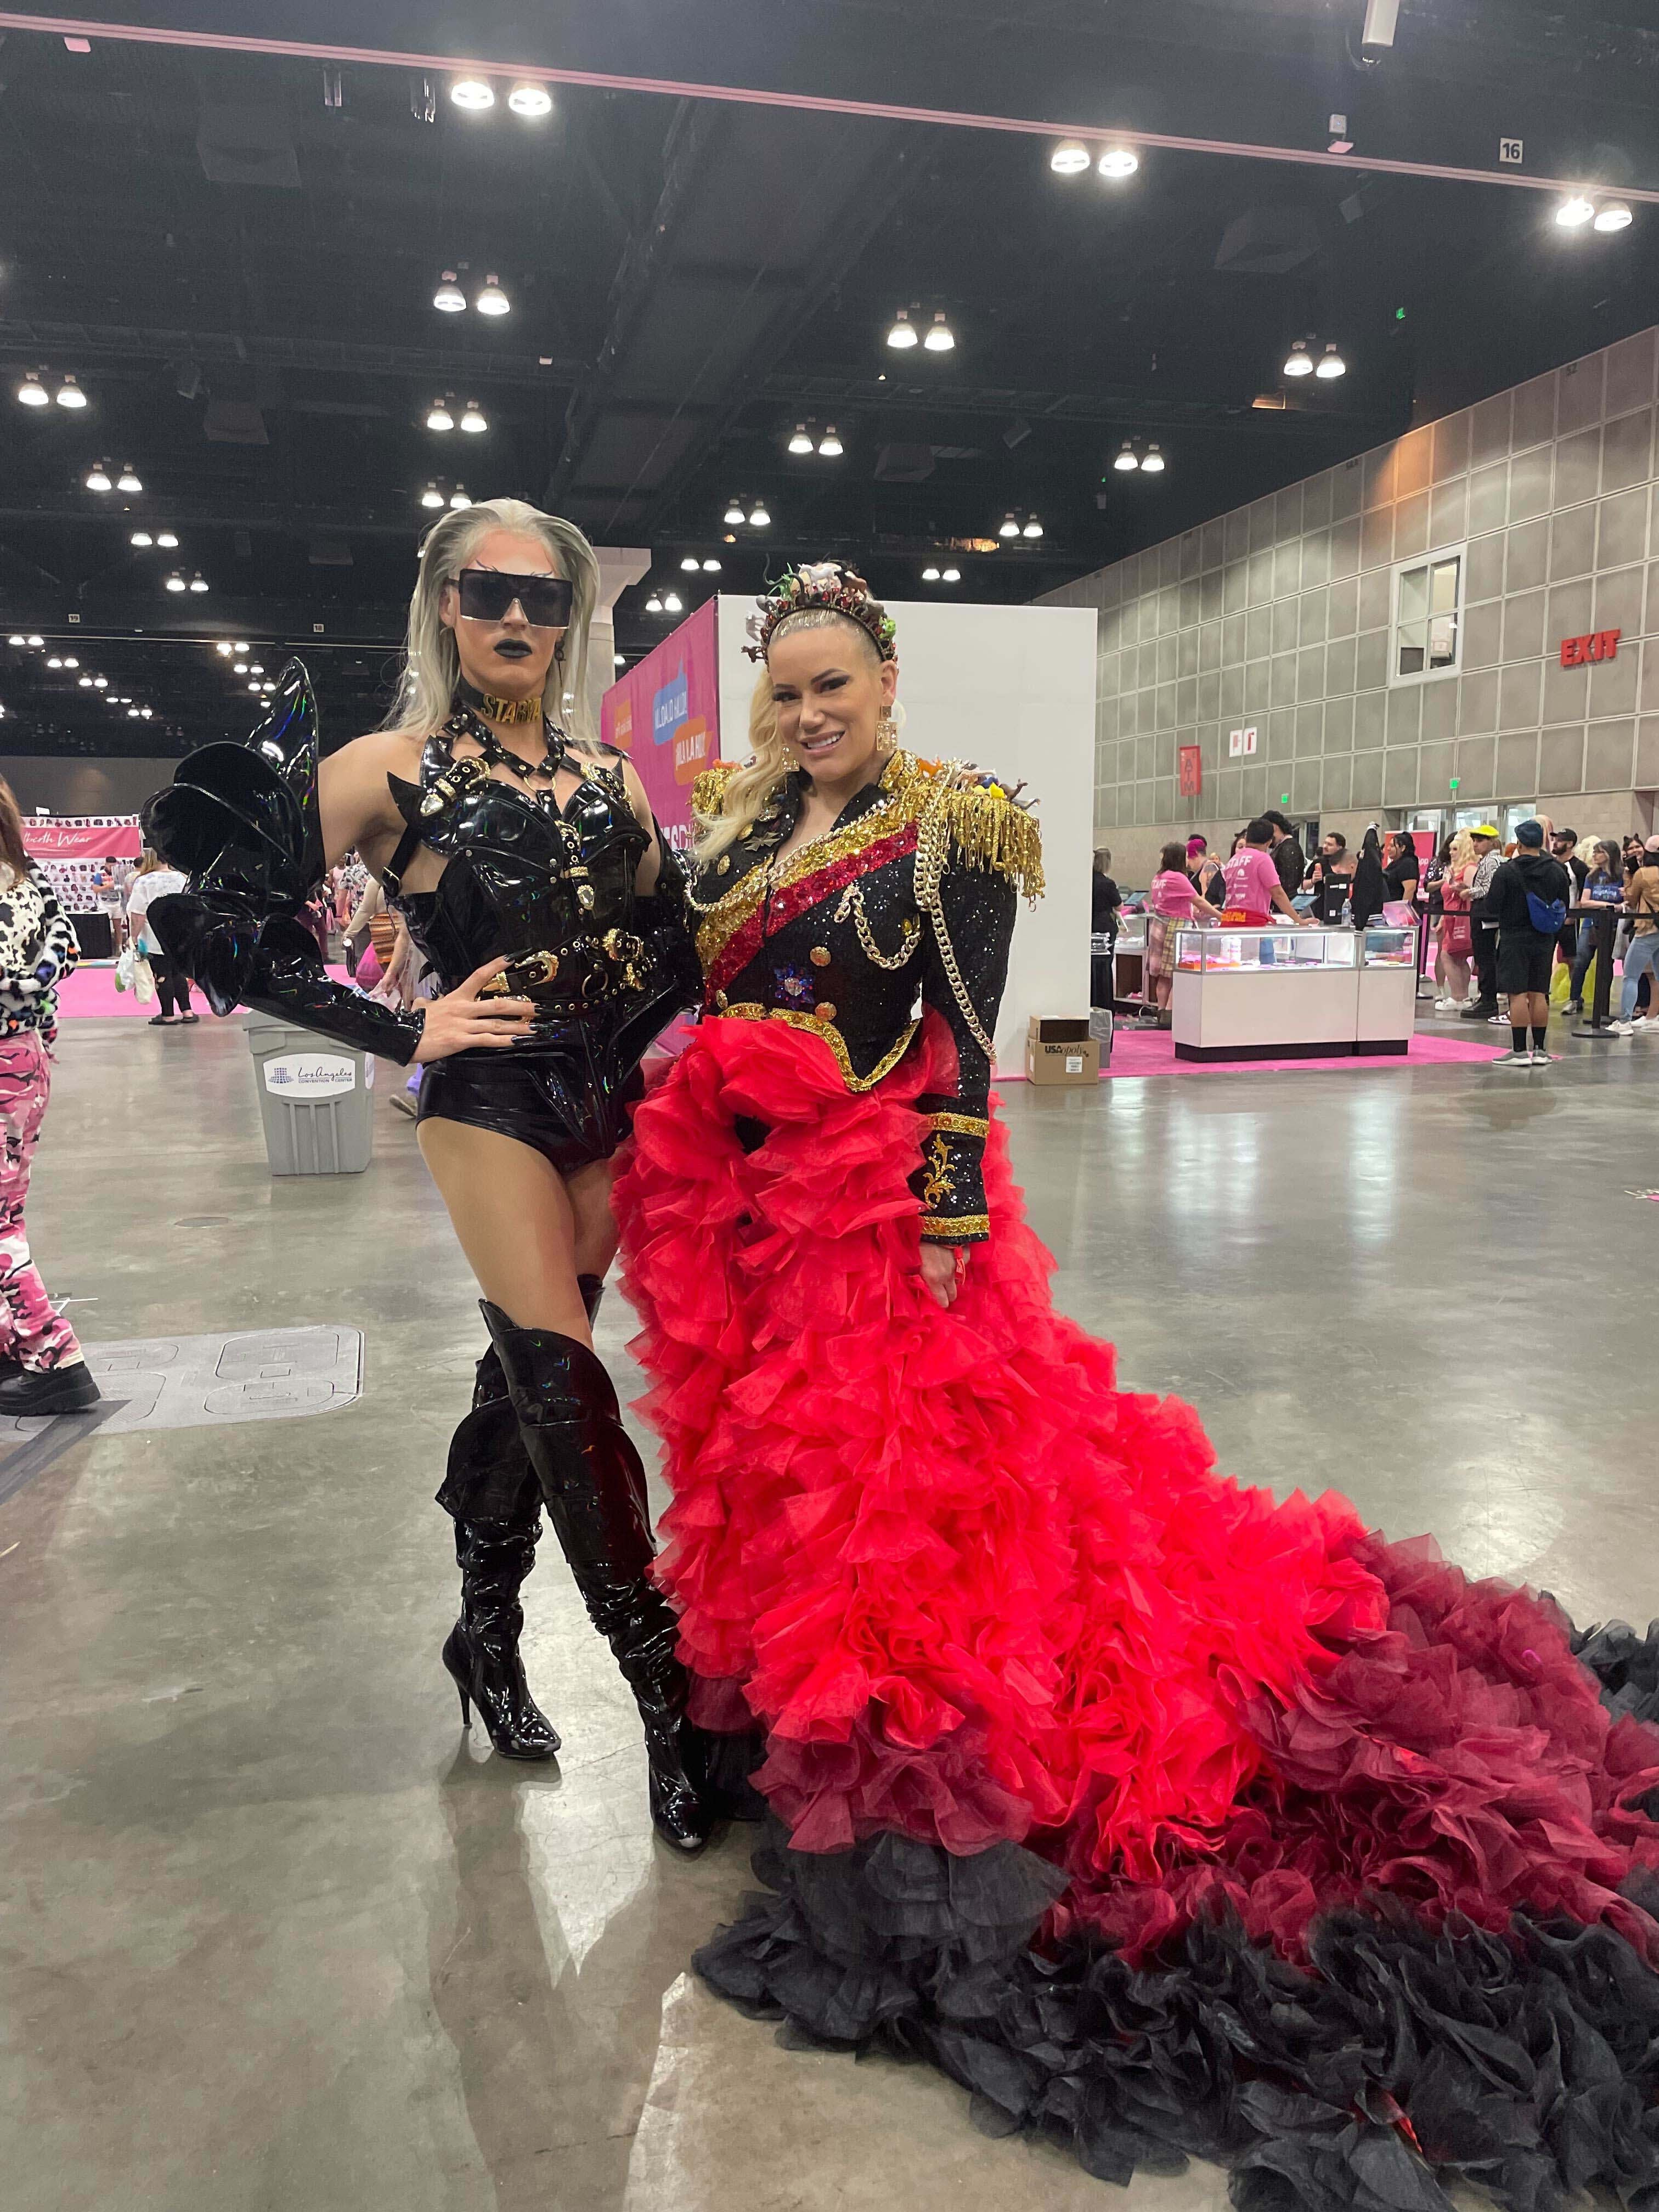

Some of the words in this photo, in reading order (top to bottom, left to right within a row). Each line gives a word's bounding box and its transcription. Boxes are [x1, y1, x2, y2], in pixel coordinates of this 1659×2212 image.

[1502, 143, 1520, 159] 16
[1560, 628, 1621, 667] EXIT
[1184, 758, 1194, 792] ATM
[57, 832, 92, 847] Wear
[1151, 879, 1167, 889] TAFF
[298, 1067, 314, 1077] Los
[315, 1066, 352, 1081] Angeles
